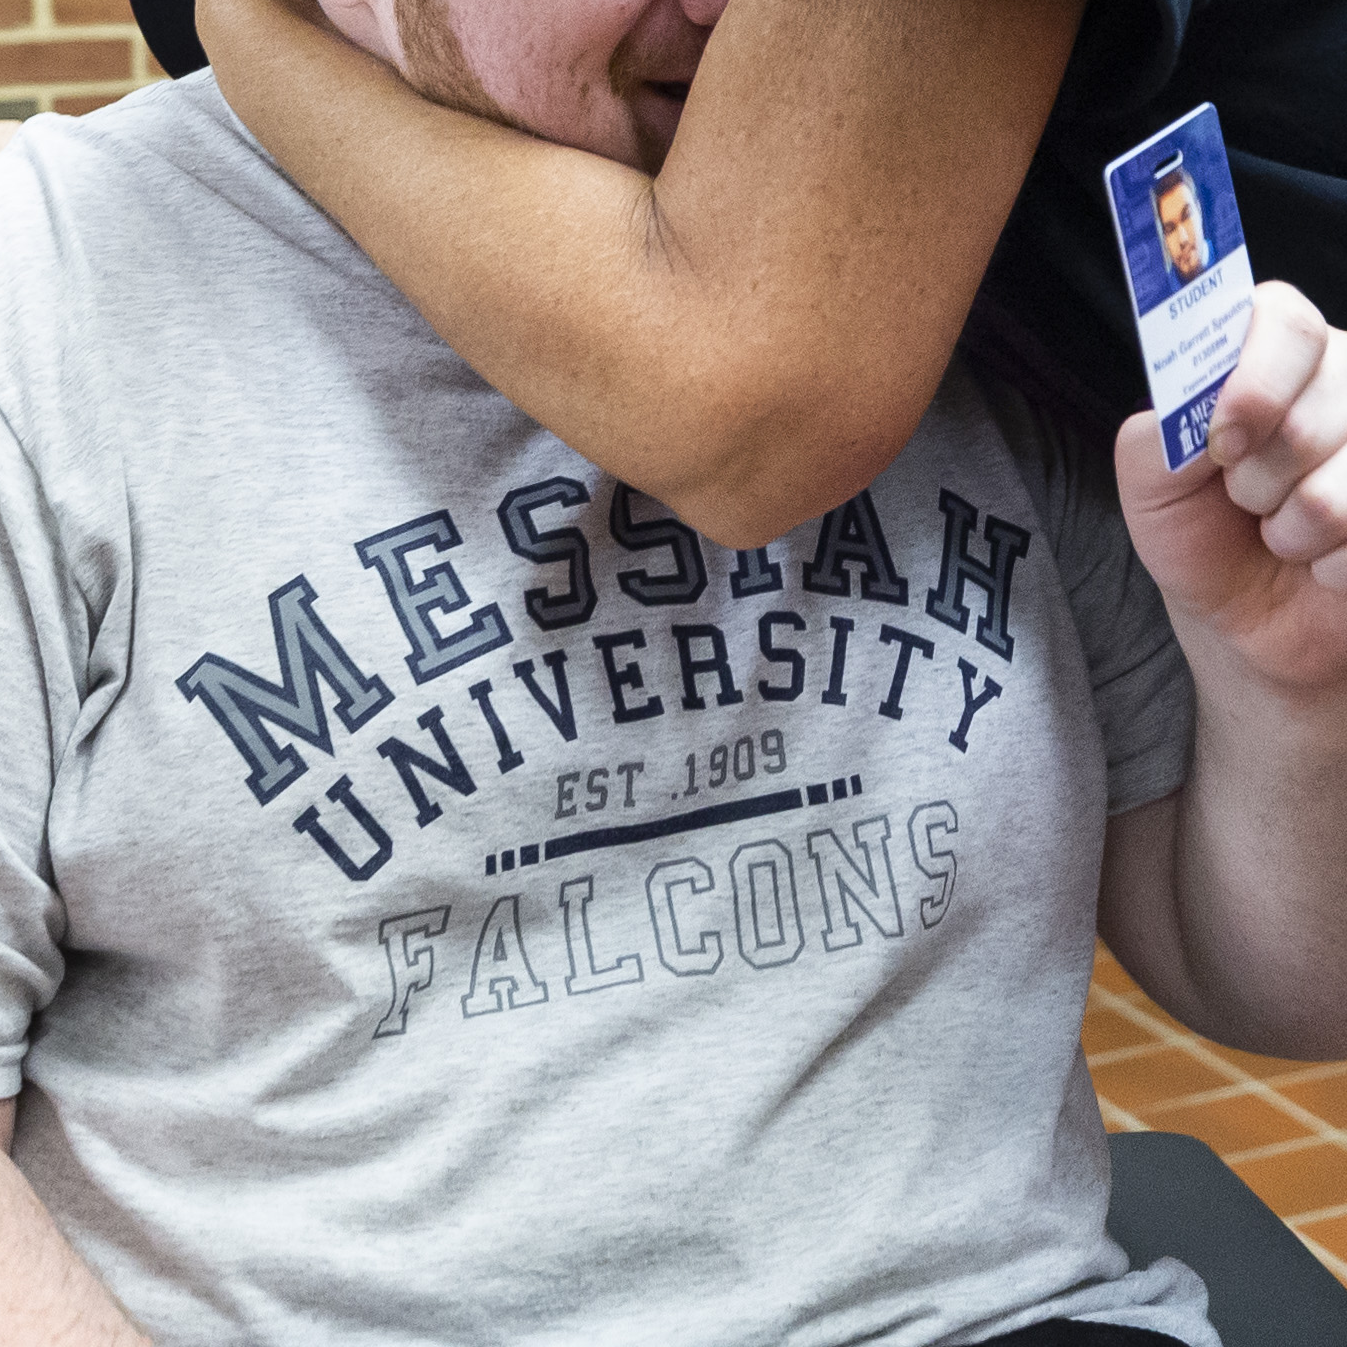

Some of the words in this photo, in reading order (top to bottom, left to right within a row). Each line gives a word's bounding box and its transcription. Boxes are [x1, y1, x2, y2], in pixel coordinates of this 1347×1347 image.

[1169, 267, 1224, 321] STUDENT
[292, 609, 1003, 882] UNIVERSITY
[554, 763, 645, 820] EST
[372, 799, 960, 1039] FALCONS
